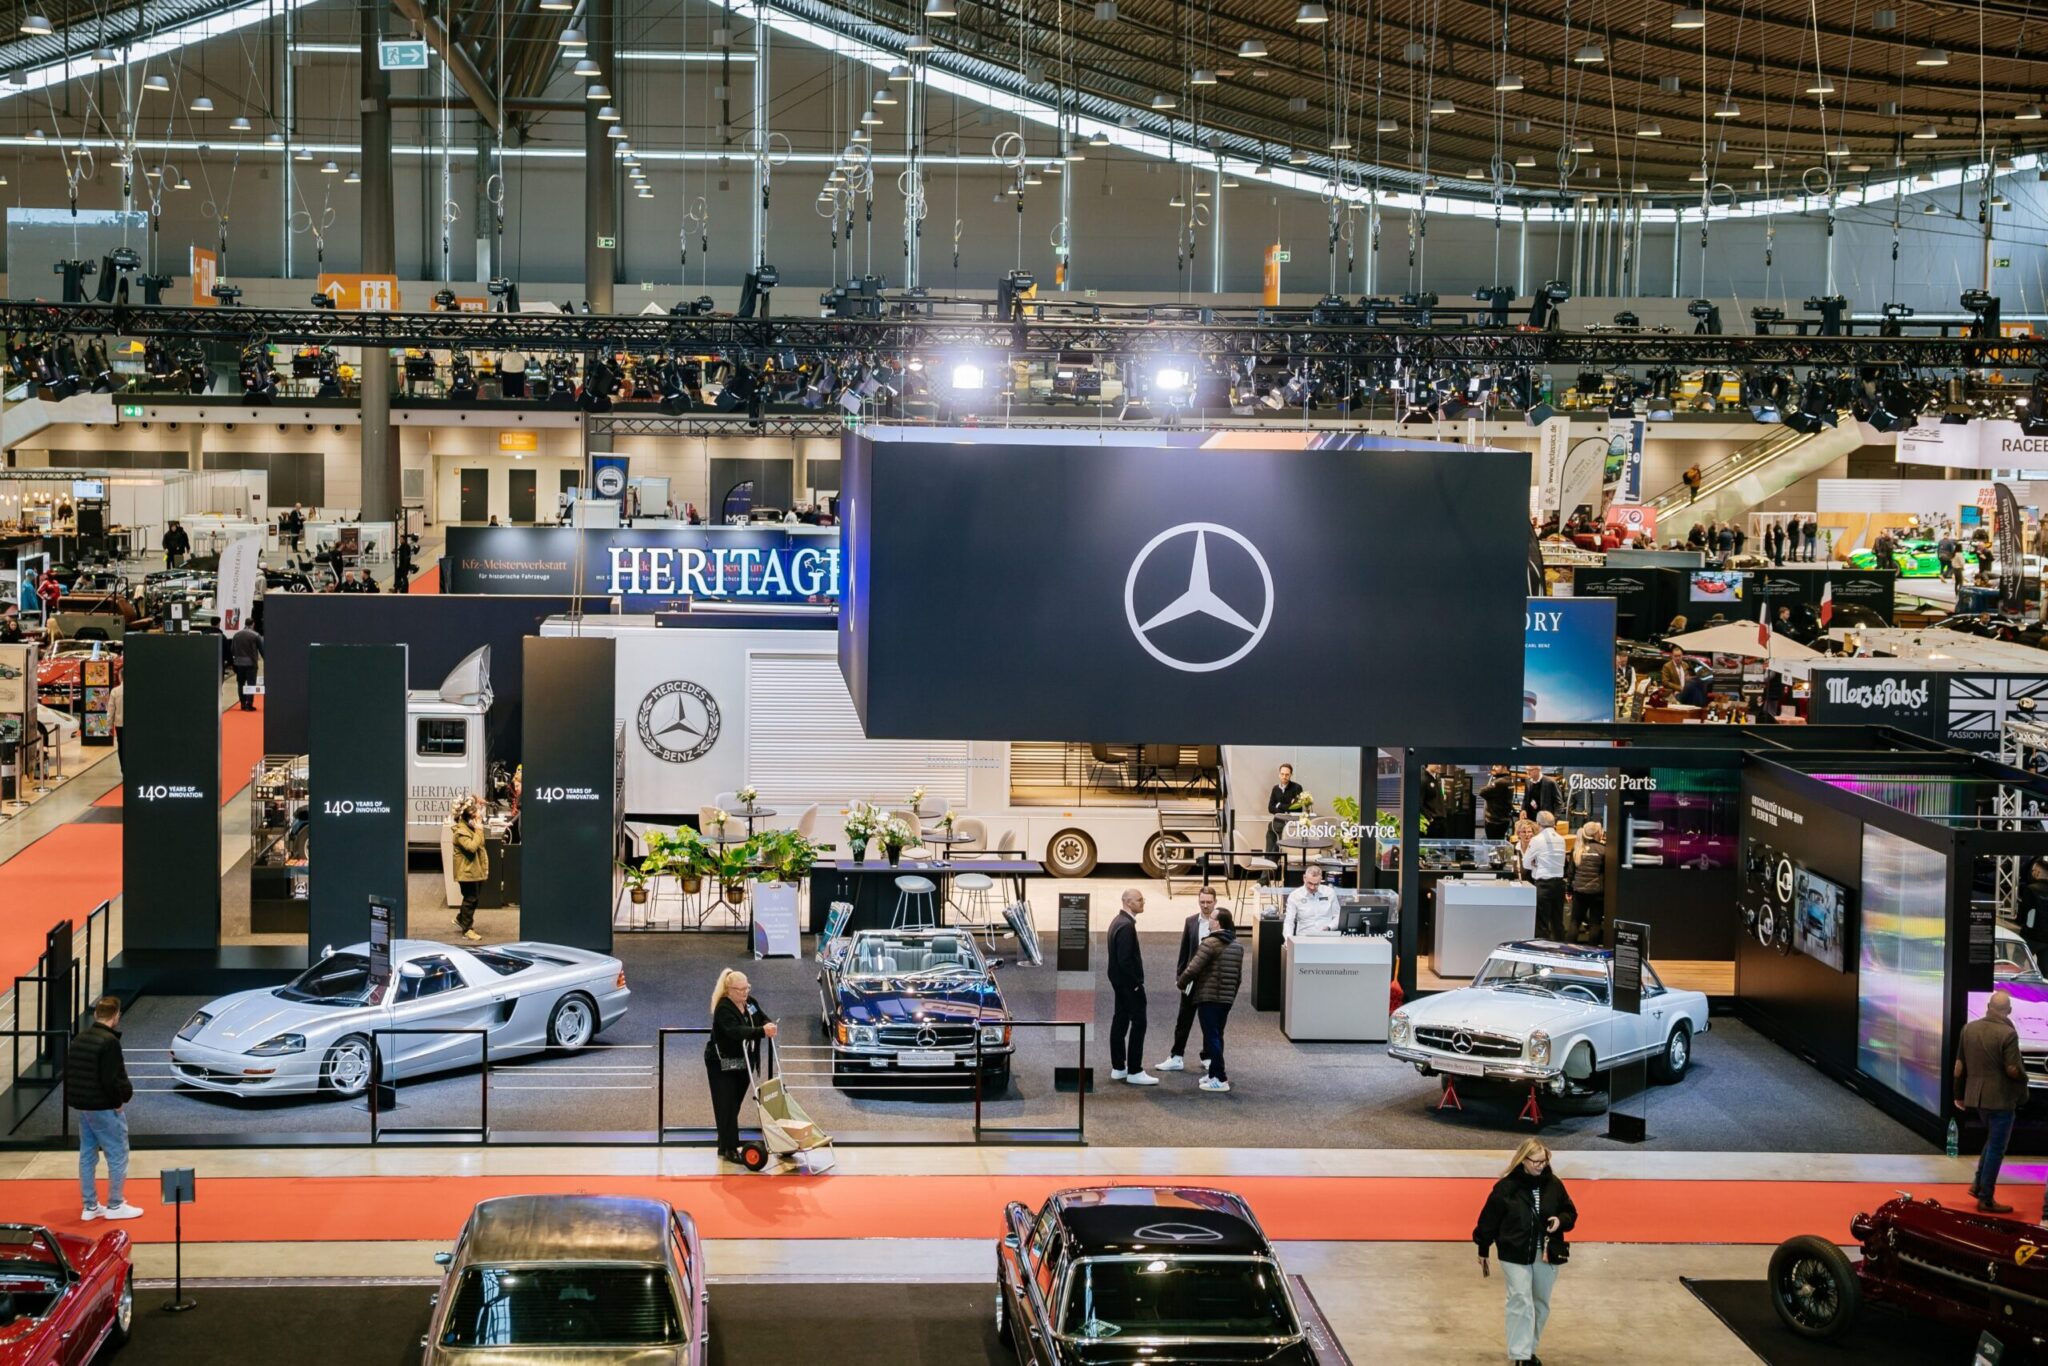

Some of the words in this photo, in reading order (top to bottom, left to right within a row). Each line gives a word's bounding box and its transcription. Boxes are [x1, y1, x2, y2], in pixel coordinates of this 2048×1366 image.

[1904, 428, 1940, 438] ORSCHE
[462, 559, 567, 571] Kfz-Meisterwerkstatt
[651, 681, 707, 700] MERCEDES
[1948, 731, 1980, 739] PASSION
[1983, 731, 2000, 739] FOR
[662, 750, 695, 762] BENZ
[1569, 773, 1617, 790] Classic
[1620, 774, 1657, 791] Parts
[138, 785, 167, 801] 140
[412, 785, 470, 798] HERITAGE
[535, 787, 564, 803] 140
[324, 800, 354, 817] 140
[415, 800, 451, 812] CREAT
[1285, 819, 1337, 838] Classic
[1340, 820, 1396, 838] Service
[1298, 968, 1360, 976] Serviceannahme
